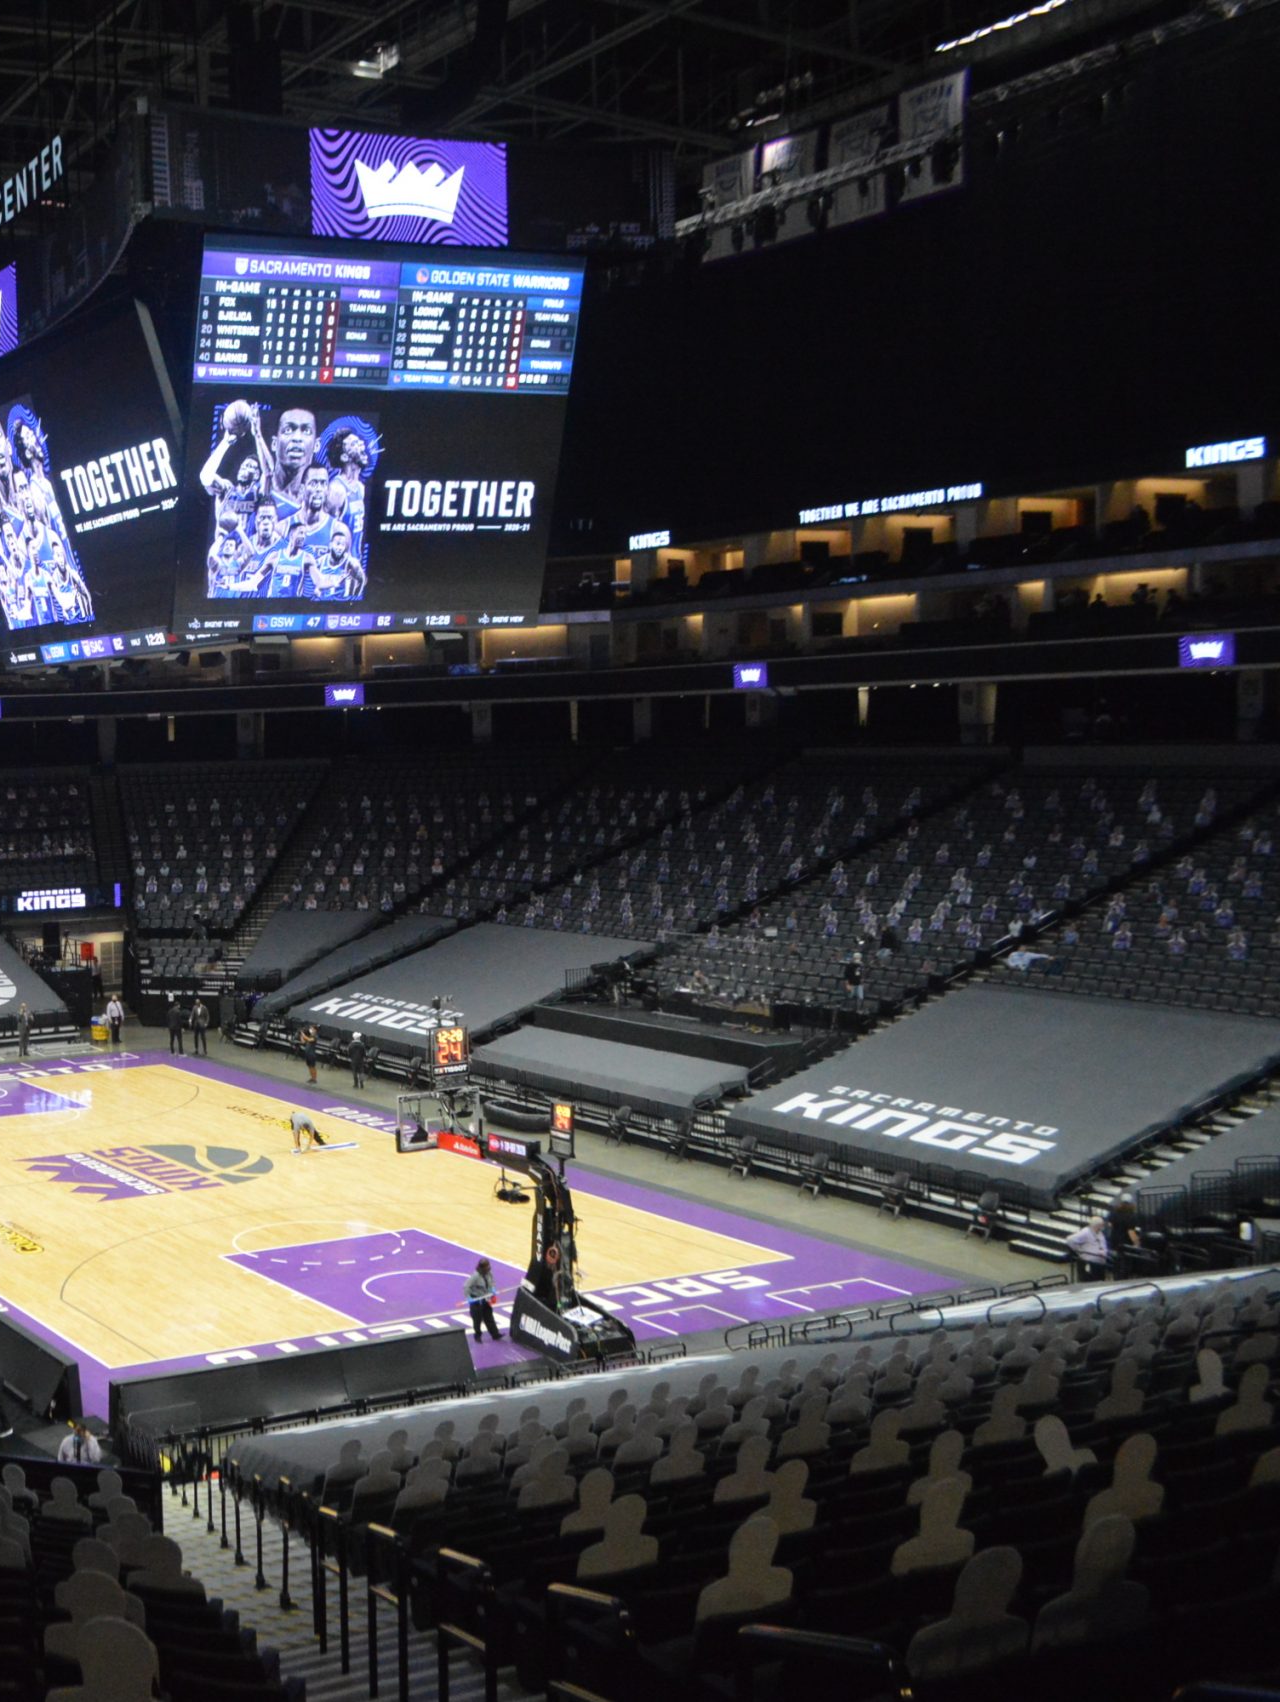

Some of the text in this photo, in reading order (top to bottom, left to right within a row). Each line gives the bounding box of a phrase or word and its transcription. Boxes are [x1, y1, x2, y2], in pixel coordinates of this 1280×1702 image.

[250, 259, 371, 279] SACRAMENTO KINGS
[215, 280, 261, 294] IN-GAME
[431, 270, 570, 291] GOLDEN STATE WARRIORS
[219, 296, 236, 307] FOX
[1185, 437, 1266, 468] KINGS
[60, 437, 178, 515] TOGETHER
[385, 480, 535, 517] TOGETHER
[844, 501, 860, 518] WE
[380, 523, 391, 532] WE
[391, 523, 406, 532] ARE
[406, 523, 451, 532] SACRAMENTO
[451, 523, 475, 532] PROUD
[629, 530, 671, 551] KINGS
[270, 616, 295, 628] GSW
[307, 616, 321, 627] 47
[340, 616, 361, 627] SAC
[71, 643, 79, 656] 47
[17, 894, 86, 911] KINGS
[310, 997, 458, 1035] KINGS
[438, 1042, 462, 1064] 24
[827, 1085, 1059, 1137] SACRAMENTO
[772, 1092, 1058, 1164] KINGS
[65, 1153, 166, 1195] SACRAMENTO
[93, 1147, 225, 1191] KINGS
